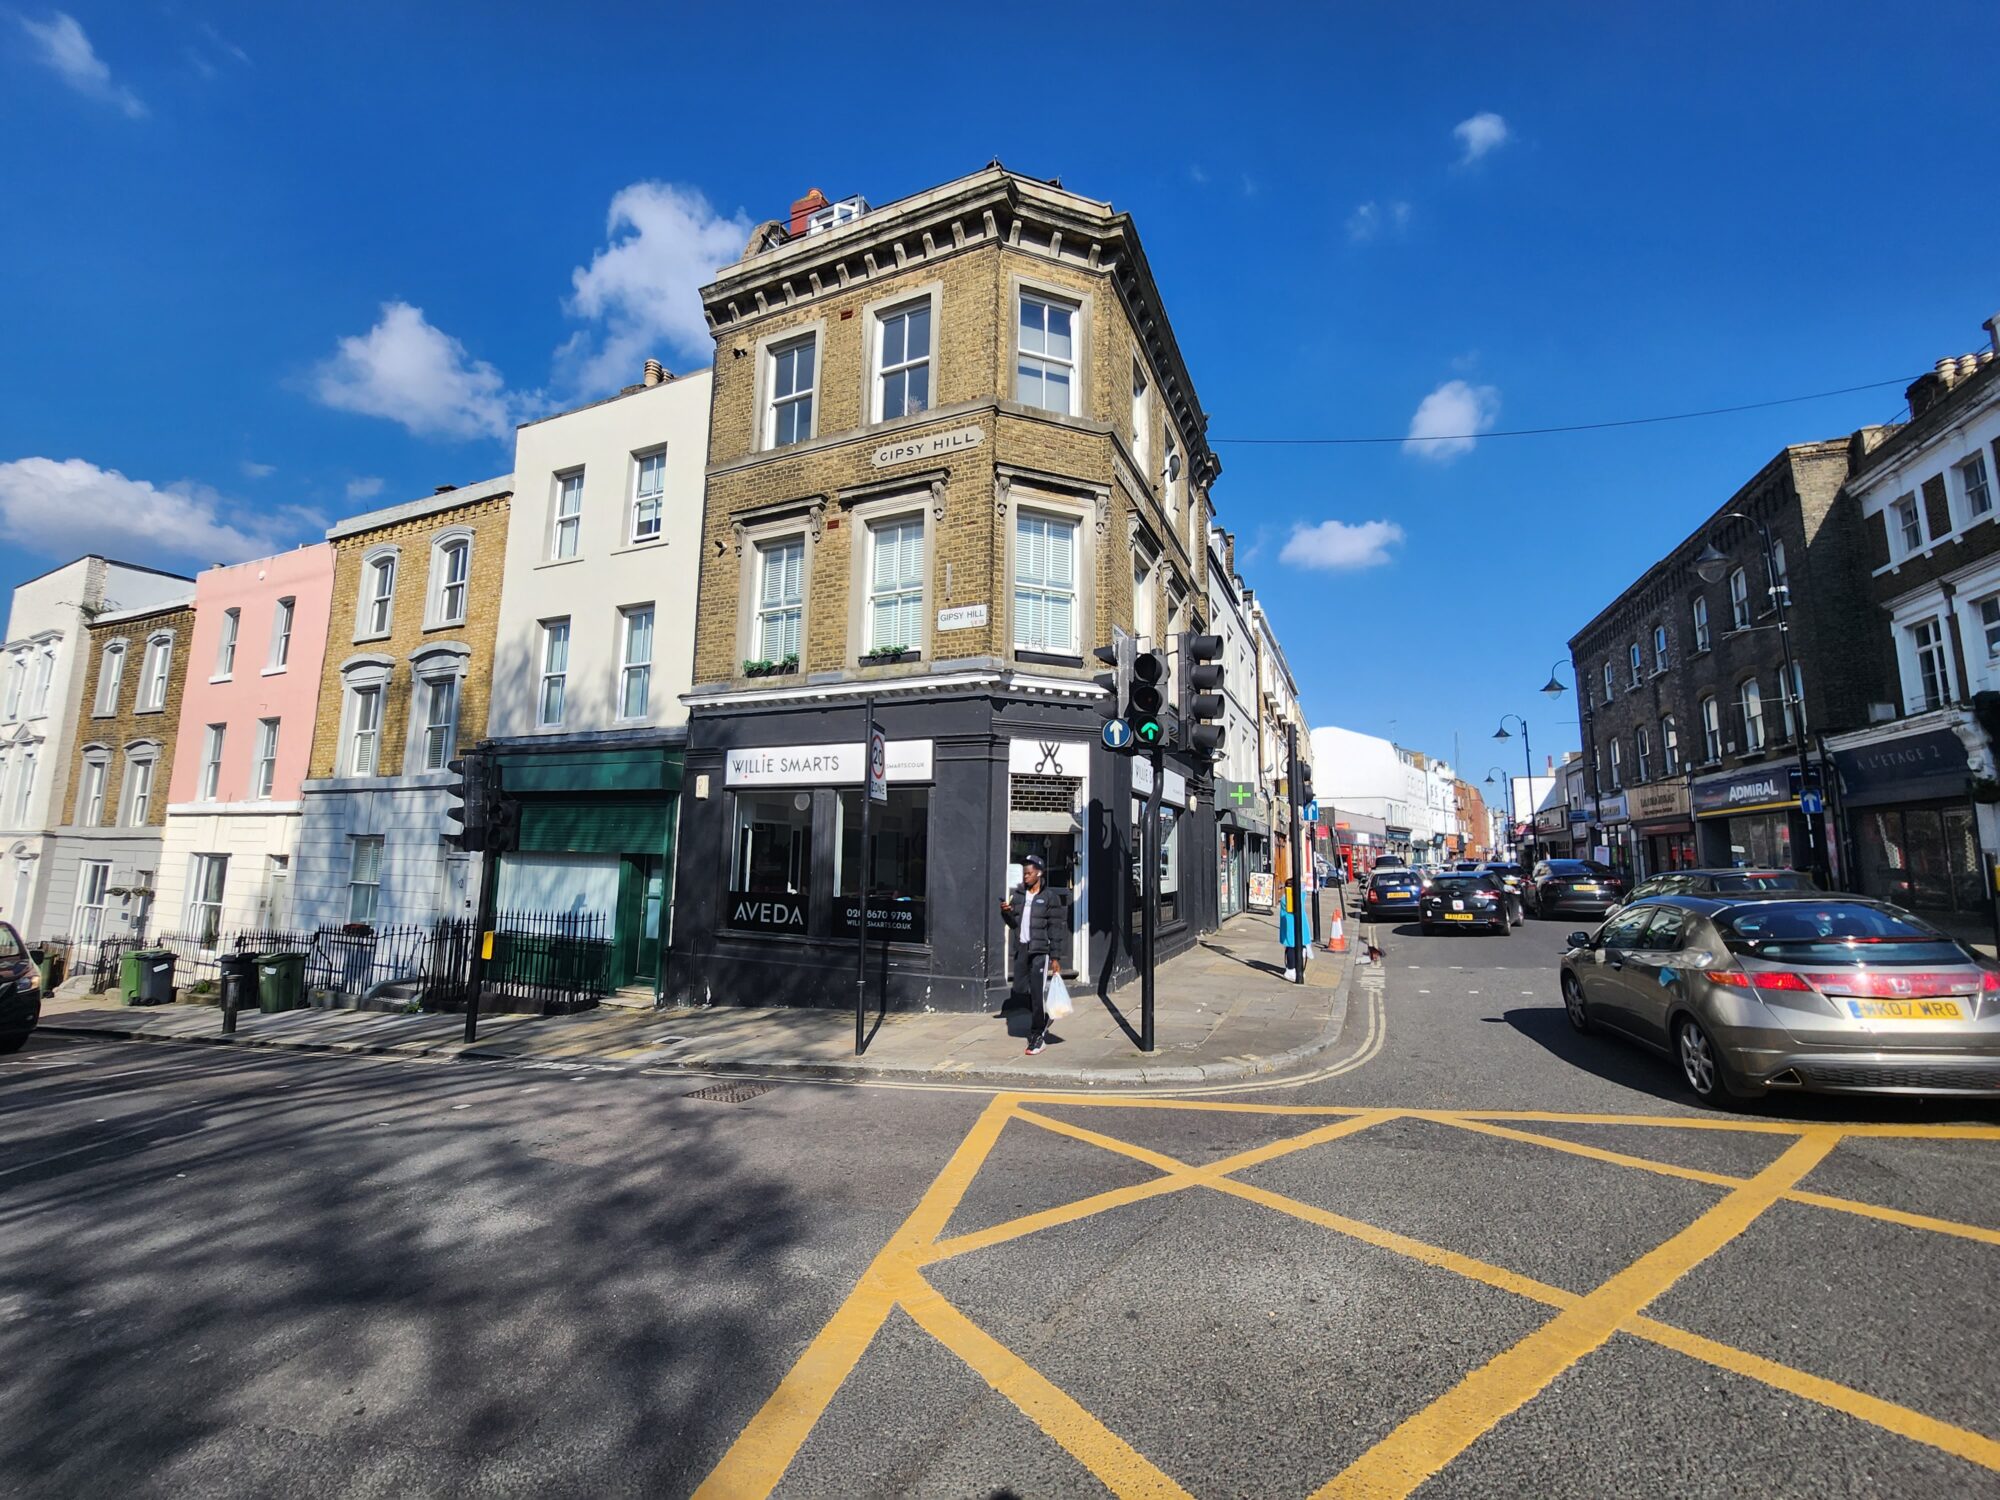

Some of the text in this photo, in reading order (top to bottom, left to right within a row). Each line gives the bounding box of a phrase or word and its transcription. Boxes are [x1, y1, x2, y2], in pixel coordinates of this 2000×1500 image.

[879, 433, 975, 462] GIPSY HILL
[940, 609, 984, 622] GIPSY HILL
[873, 746, 884, 767] 20
[1929, 744, 1941, 758] 2
[732, 755, 840, 776] WILLIE SMARTS
[871, 780, 886, 796] ZONE
[1728, 779, 1779, 802] ADMIRAL
[733, 901, 804, 926] AVEDA
[866, 909, 888, 919] 8670
[890, 911, 913, 921] 9798
